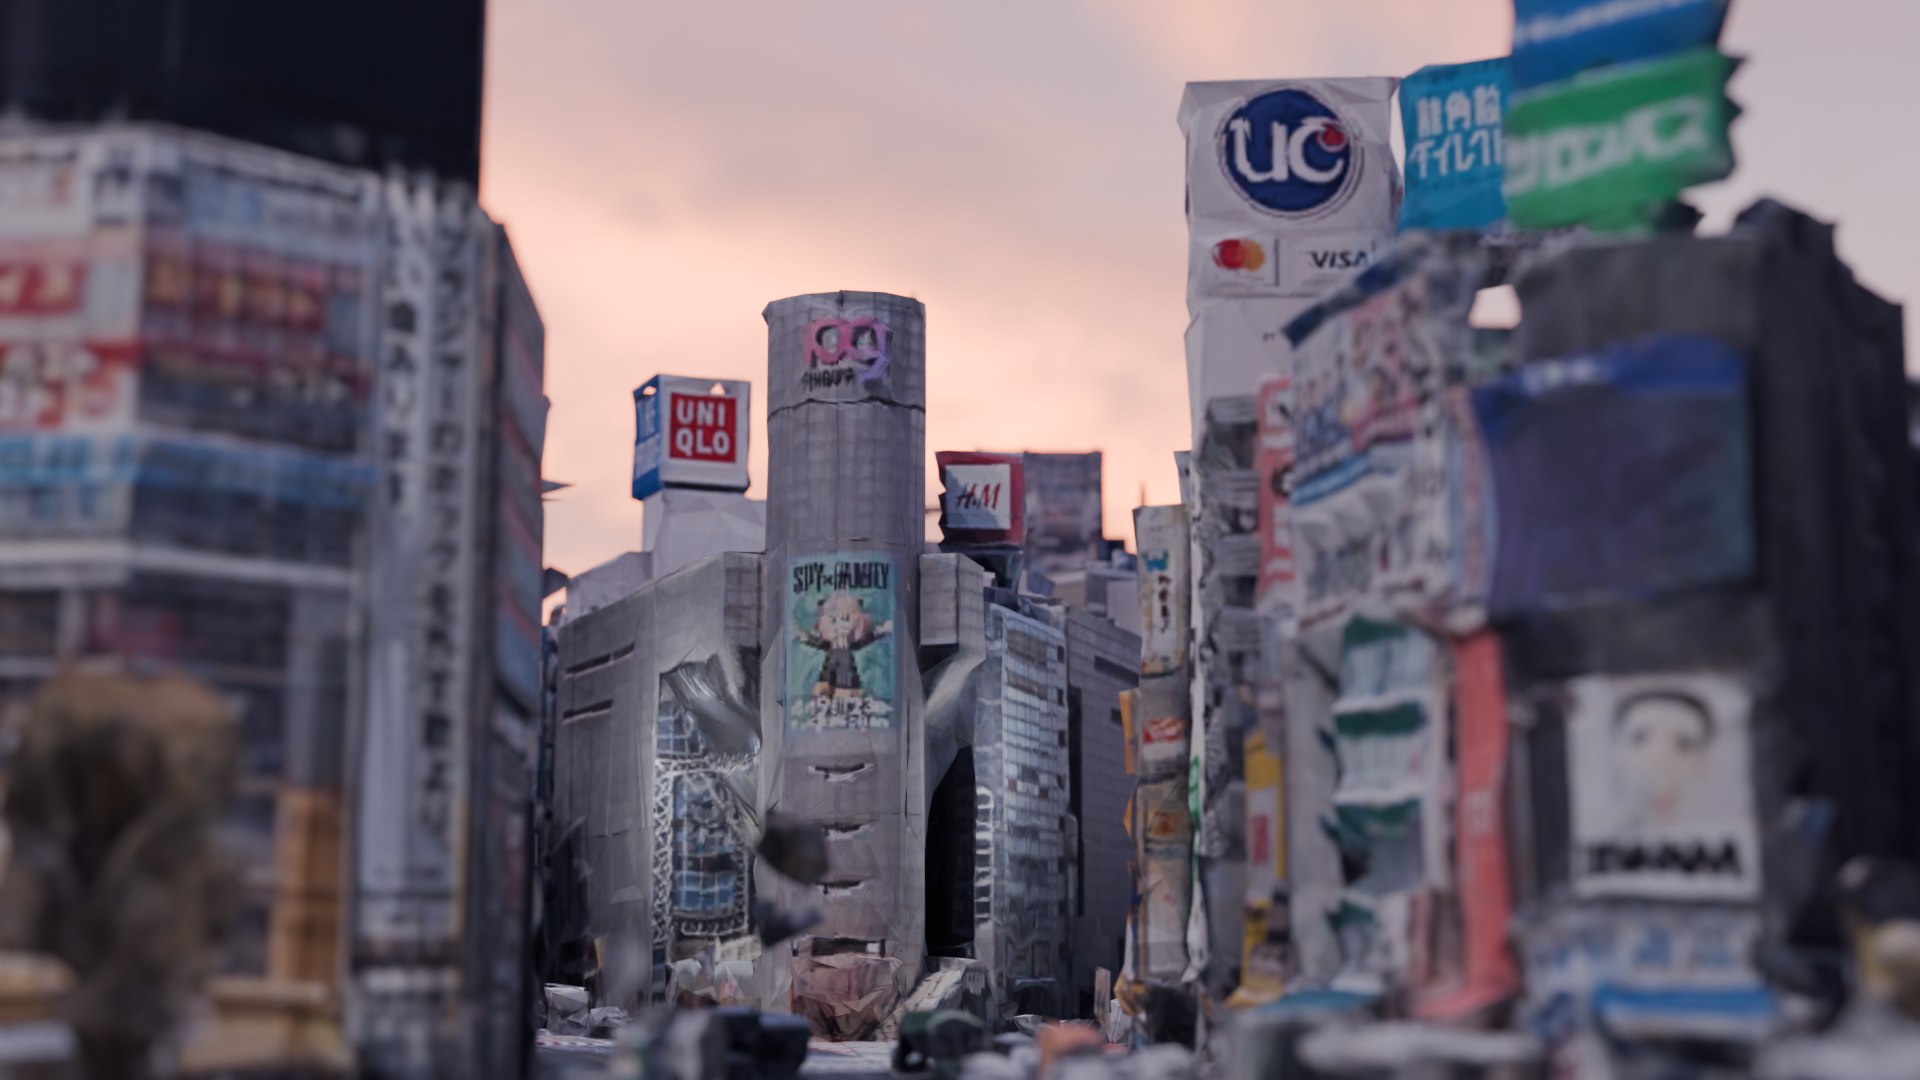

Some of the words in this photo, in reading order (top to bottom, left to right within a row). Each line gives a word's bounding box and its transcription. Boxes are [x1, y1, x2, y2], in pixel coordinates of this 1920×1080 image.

[1311, 250, 1368, 269] VISA
[677, 398, 726, 426] UNI
[676, 427, 730, 457] QLO
